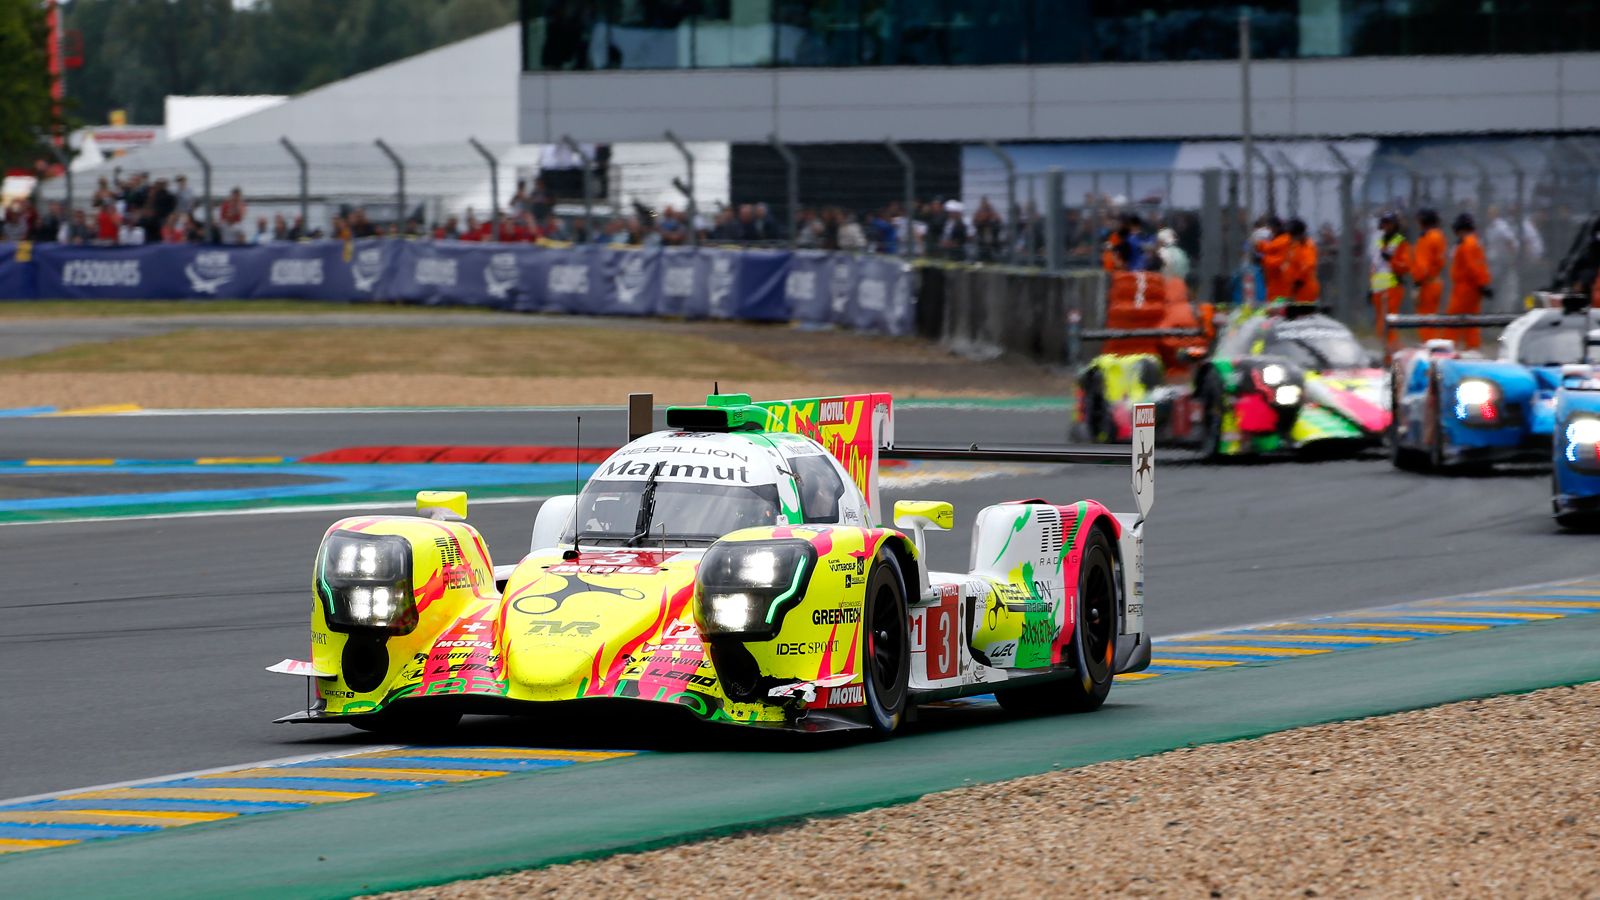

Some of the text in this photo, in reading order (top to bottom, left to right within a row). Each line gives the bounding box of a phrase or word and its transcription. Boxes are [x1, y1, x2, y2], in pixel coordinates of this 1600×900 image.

[819, 400, 844, 421] MOTUL
[1136, 408, 1155, 424] MOTUL
[613, 445, 748, 463] REBELLION
[599, 459, 750, 484] Matmut
[593, 552, 639, 564] 3
[1040, 555, 1078, 566] RACING
[812, 607, 862, 625] GREENTECH
[529, 619, 601, 635] TVR
[435, 640, 495, 649] MOTUL
[644, 643, 705, 652] MOTUL
[776, 640, 840, 656] IDEC SPORT
[938, 611, 951, 674] 3
[990, 643, 1016, 658] WEC
[638, 655, 713, 668] NORTHWIRE
[649, 668, 717, 687] LEMO
[829, 686, 863, 705] MOTUL
